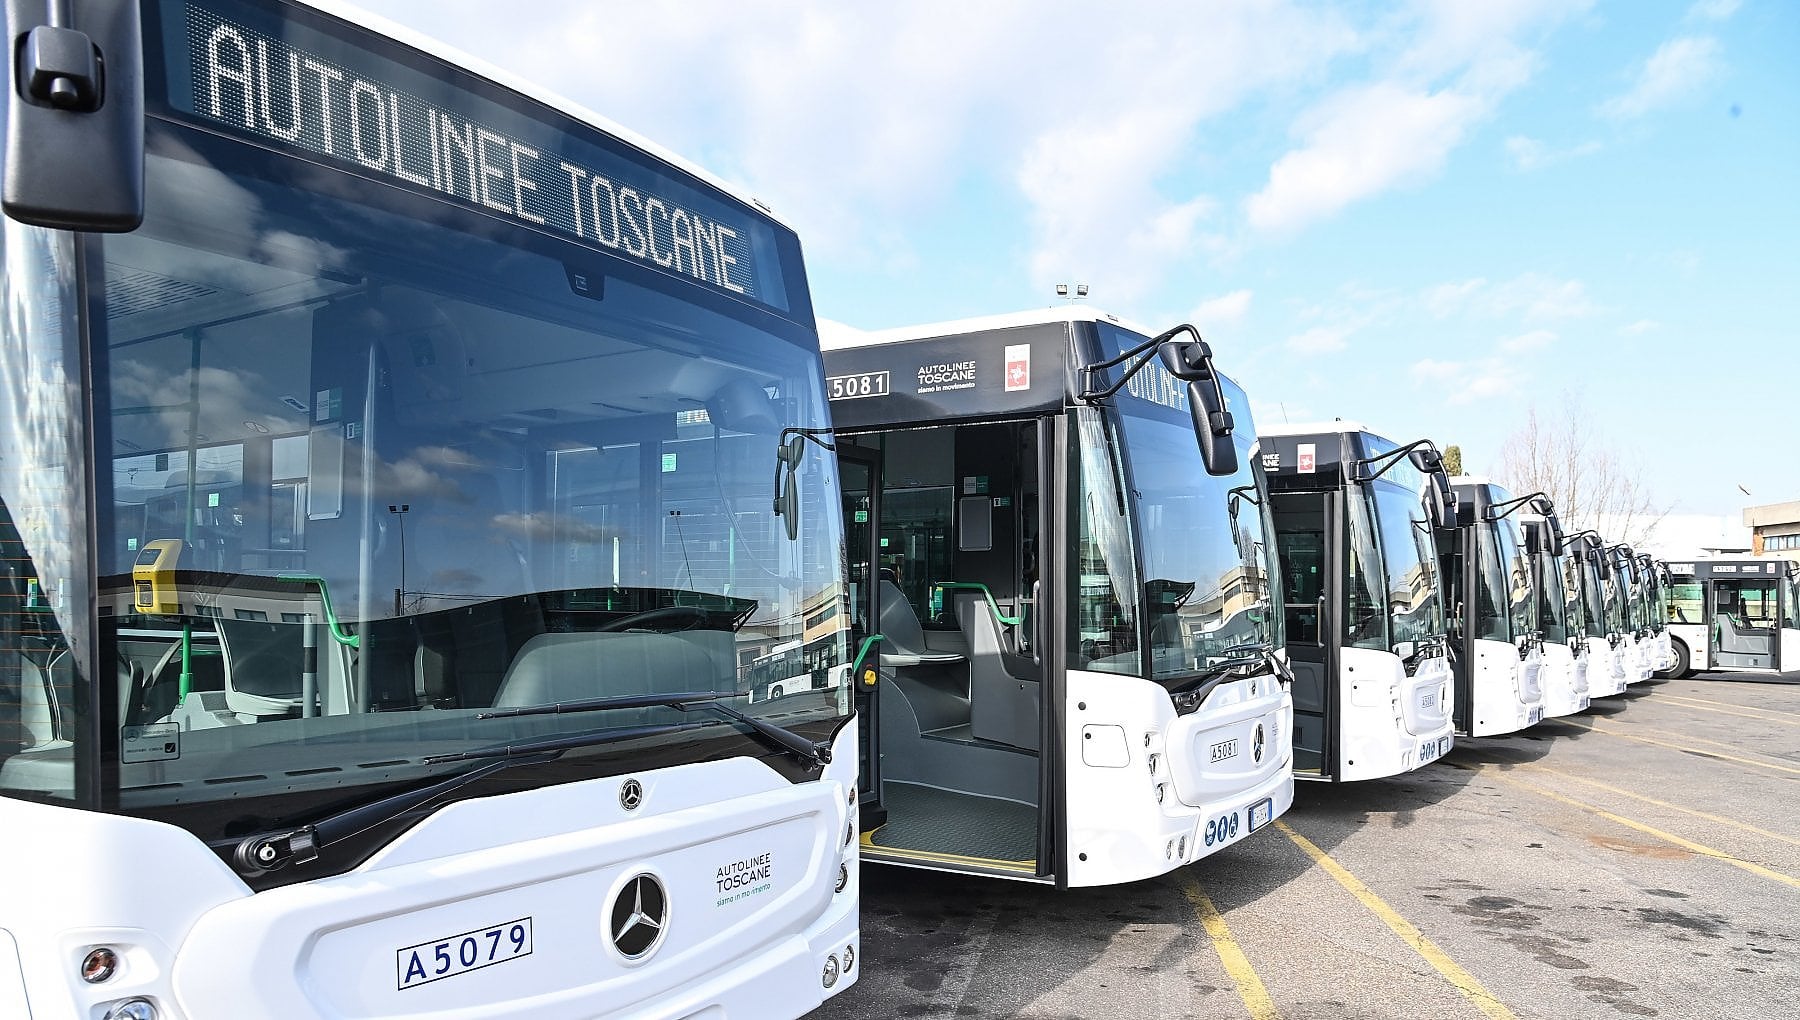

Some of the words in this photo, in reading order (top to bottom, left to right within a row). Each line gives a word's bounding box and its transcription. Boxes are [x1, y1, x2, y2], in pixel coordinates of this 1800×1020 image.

[208, 23, 545, 225] AUTOLINEE
[561, 161, 744, 293] TOSCANE
[917, 360, 976, 375] AUTOLINEE
[917, 369, 976, 385] TOSCANE
[828, 374, 883, 398] 5081
[1211, 741, 1236, 760] A5081
[716, 852, 771, 878] AUTOLINEE
[716, 865, 771, 893] TOSCANE
[741, 883, 771, 899] moimento
[404, 925, 525, 983] A5079
